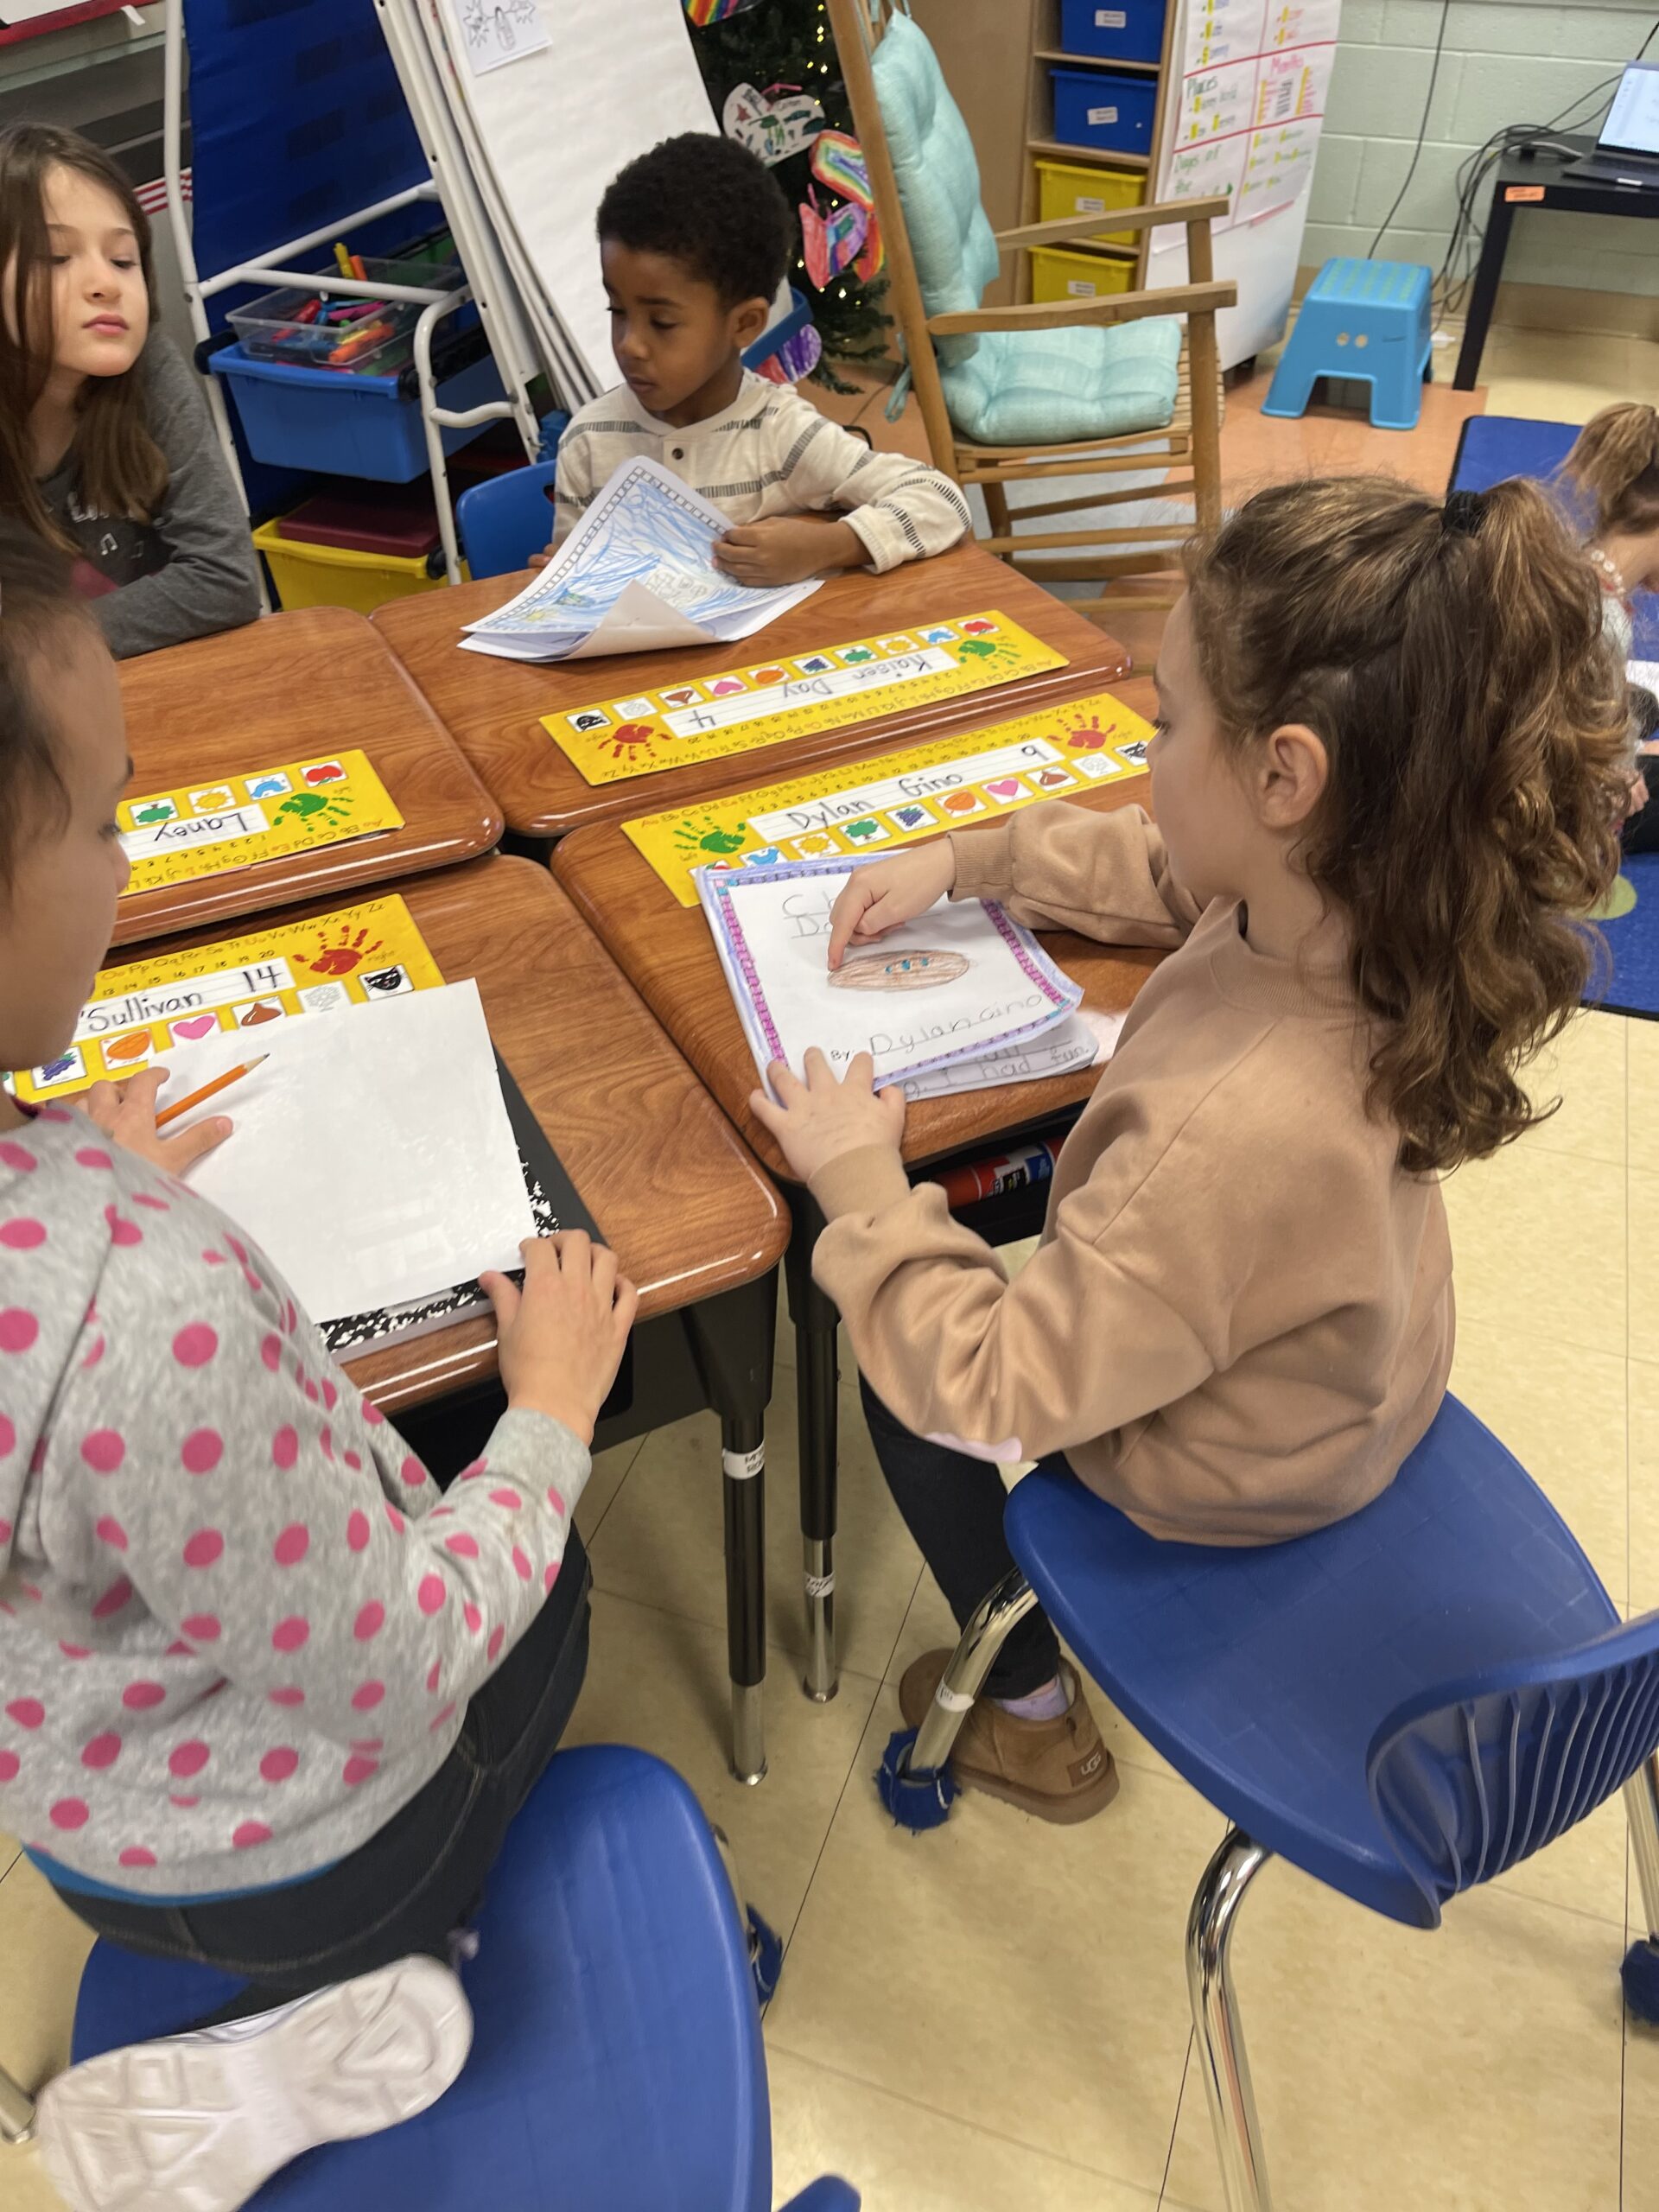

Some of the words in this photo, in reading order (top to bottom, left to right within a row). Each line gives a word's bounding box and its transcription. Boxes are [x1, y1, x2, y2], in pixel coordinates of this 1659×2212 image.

[783, 679, 834, 697] Day
[689, 709, 716, 728] 4
[786, 797, 876, 830] Dylan
[899, 773, 963, 798] Gino
[1021, 745, 1050, 761] 9
[154, 812, 249, 842] Laney
[80, 992, 203, 1032] 'Sullivan
[242, 965, 283, 992] 14
[869, 1017, 971, 1056] Dylan
[978, 1053, 1032, 1079] had
[1049, 1046, 1090, 1065] fun.
[1080, 1751, 1102, 1776] UGG
